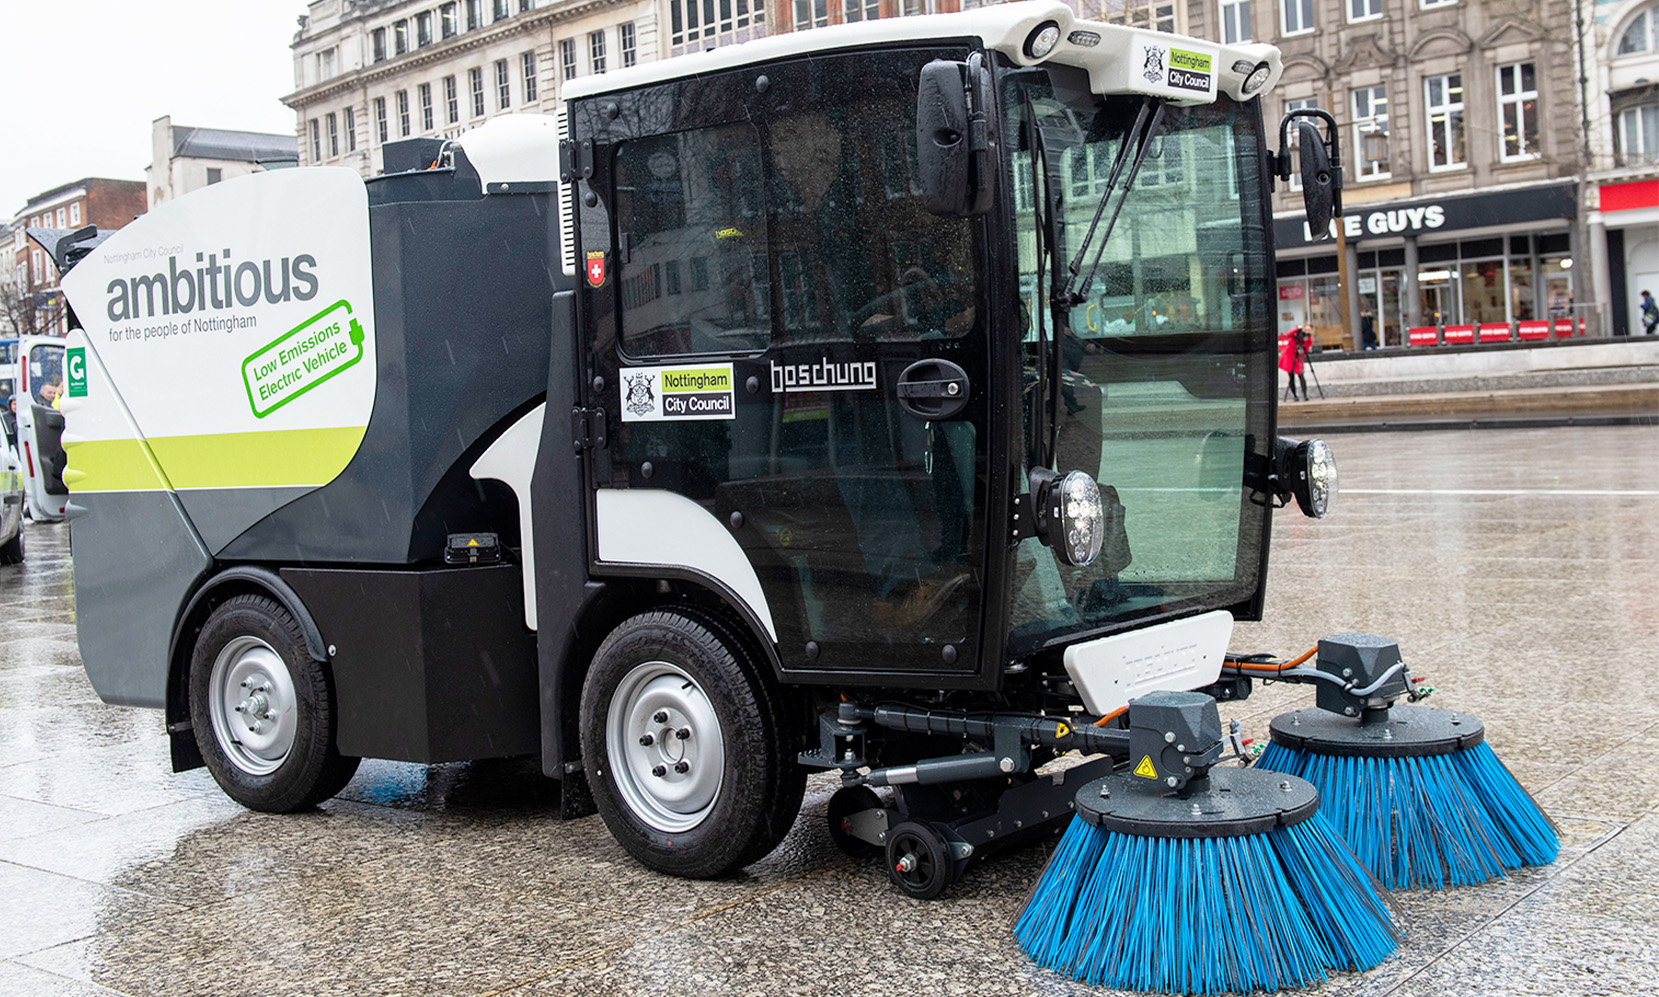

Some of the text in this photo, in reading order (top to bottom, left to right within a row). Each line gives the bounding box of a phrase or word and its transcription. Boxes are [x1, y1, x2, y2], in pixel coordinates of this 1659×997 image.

[1171, 51, 1209, 69] Nottingham
[1170, 71, 1209, 88] City Council
[1367, 205, 1446, 235] GUYS
[104, 243, 184, 265] Nottingham City Council
[106, 248, 319, 322] ambitious
[109, 314, 257, 342] for the people of Nottingham
[253, 321, 341, 381] Low Emissions
[258, 341, 348, 401] Electric Vehicle
[664, 372, 728, 390] Nottingham
[770, 356, 877, 393] boschung
[665, 395, 730, 414] City Council
